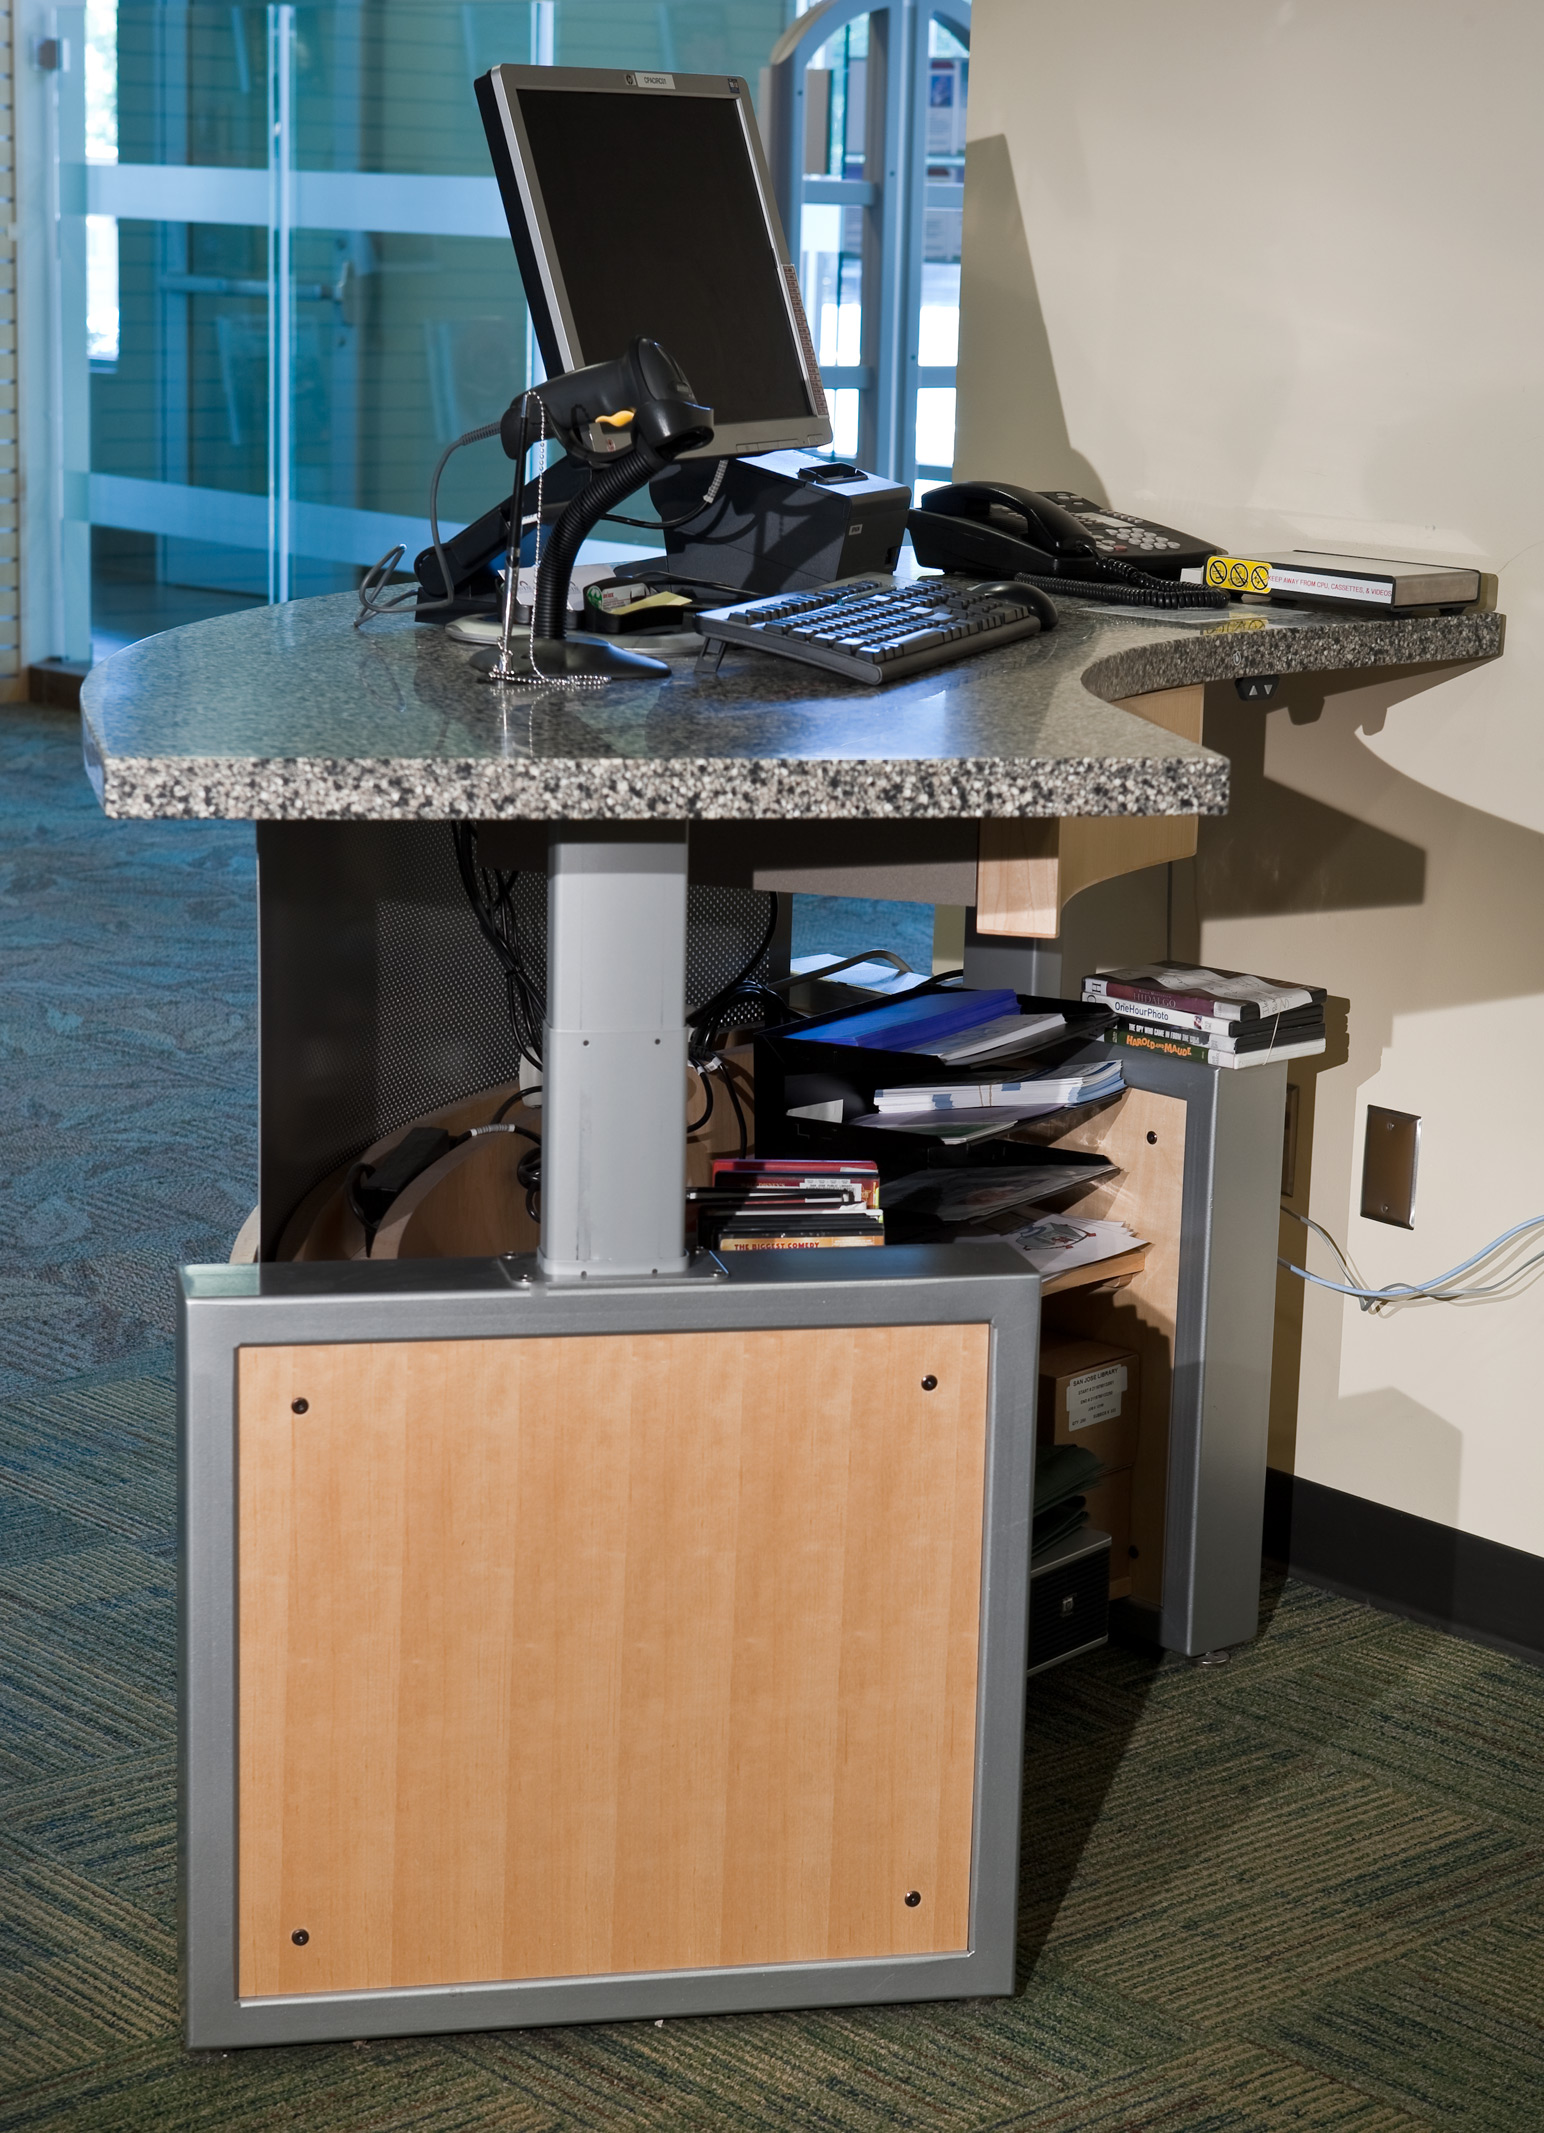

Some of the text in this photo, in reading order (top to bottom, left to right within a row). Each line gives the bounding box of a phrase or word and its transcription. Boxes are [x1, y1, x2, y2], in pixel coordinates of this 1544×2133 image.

[1268, 575, 1283, 583] KEEP
[1283, 577, 1299, 585] AWAY
[1300, 579, 1316, 587] FROM
[1331, 583, 1365, 595] CASSETTES,
[1371, 588, 1392, 597] VIDEOS
[1133, 992, 1176, 1009] HIDALGO
[1114, 1001, 1169, 1021] OneHourPhoto
[1126, 1035, 1155, 1050] HAROLD
[1164, 1043, 1192, 1057] MAUDE
[1073, 1379, 1084, 1387] SAN
[1084, 1374, 1097, 1384] JOSE
[1097, 1367, 1119, 1379] LIBRARY
